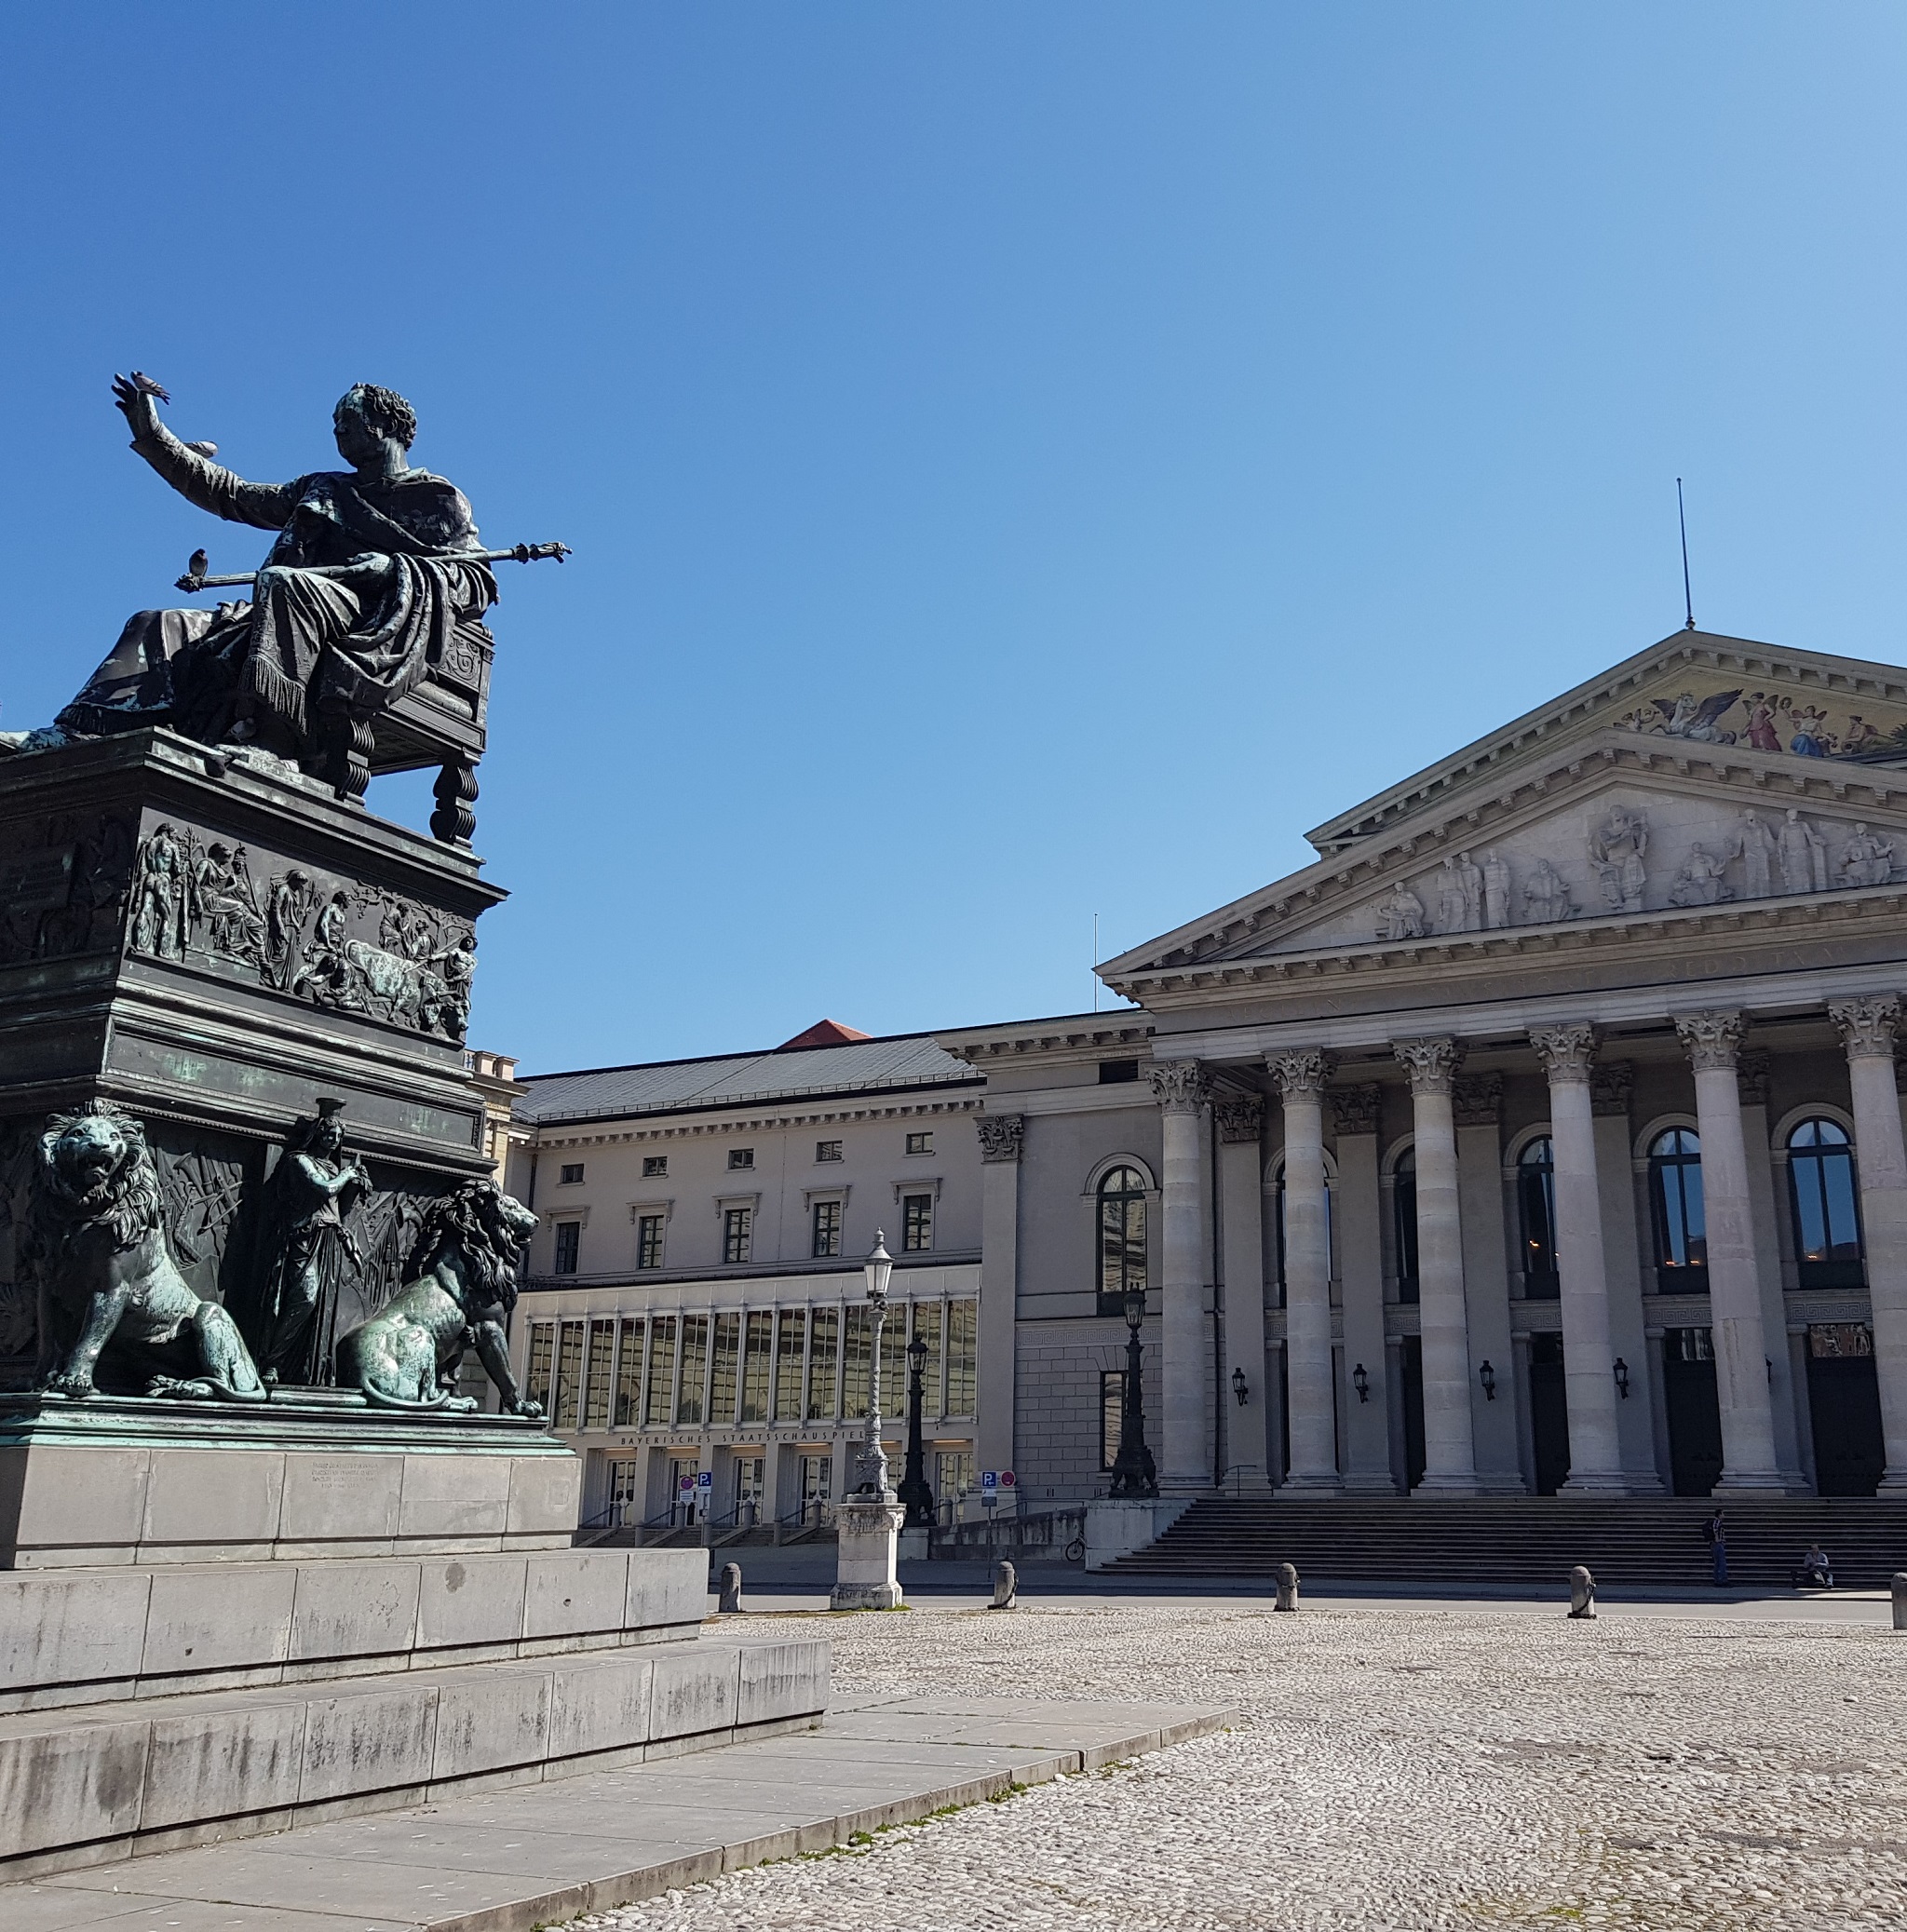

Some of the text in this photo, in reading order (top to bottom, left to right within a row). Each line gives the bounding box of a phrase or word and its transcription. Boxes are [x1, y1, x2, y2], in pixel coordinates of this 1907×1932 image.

[621, 1430, 864, 1445] BAYERISCHES STAATSSCHAUSPIEL
[699, 1473, 709, 1486] P
[984, 1473, 993, 1486] P
